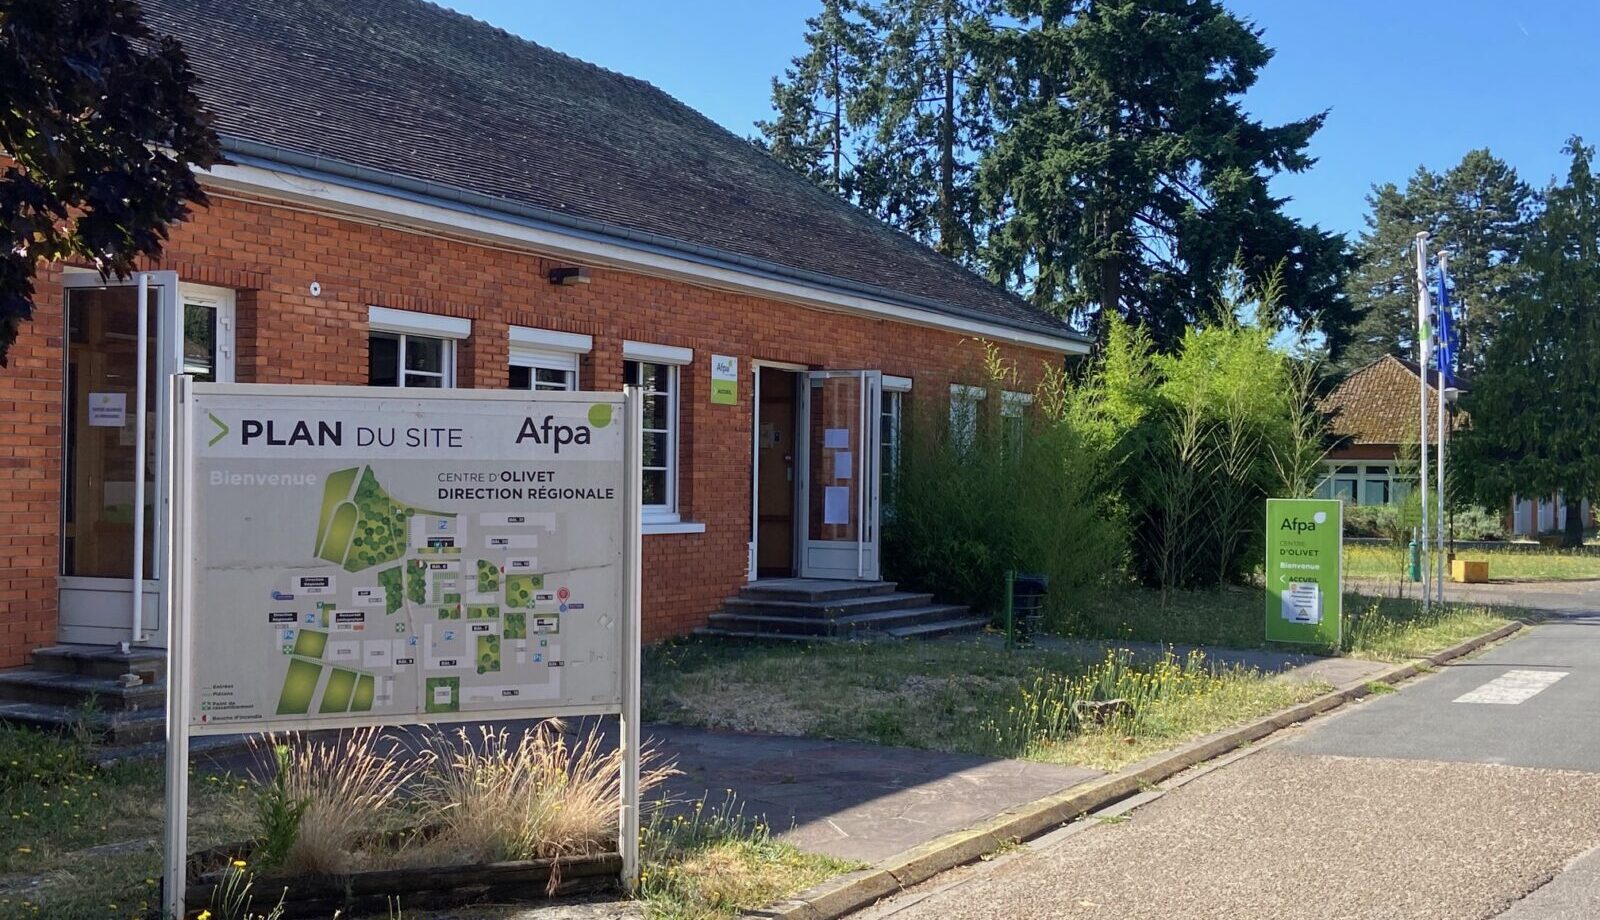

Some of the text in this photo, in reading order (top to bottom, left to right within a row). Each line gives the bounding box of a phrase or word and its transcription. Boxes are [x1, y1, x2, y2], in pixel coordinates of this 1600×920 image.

[717, 362, 729, 375] Afpa
[241, 419, 463, 448] PLAN DU SITE
[515, 415, 591, 454] Afpa
[209, 470, 317, 486] Bienvenue
[437, 470, 556, 483] CENTRE D'OLIVET
[438, 485, 614, 500] DIRECTION RÉGIONALE
[1281, 518, 1316, 534] Afpa
[1280, 548, 1319, 556] D'OLIVET
[1280, 562, 1319, 571] Bienvenue
